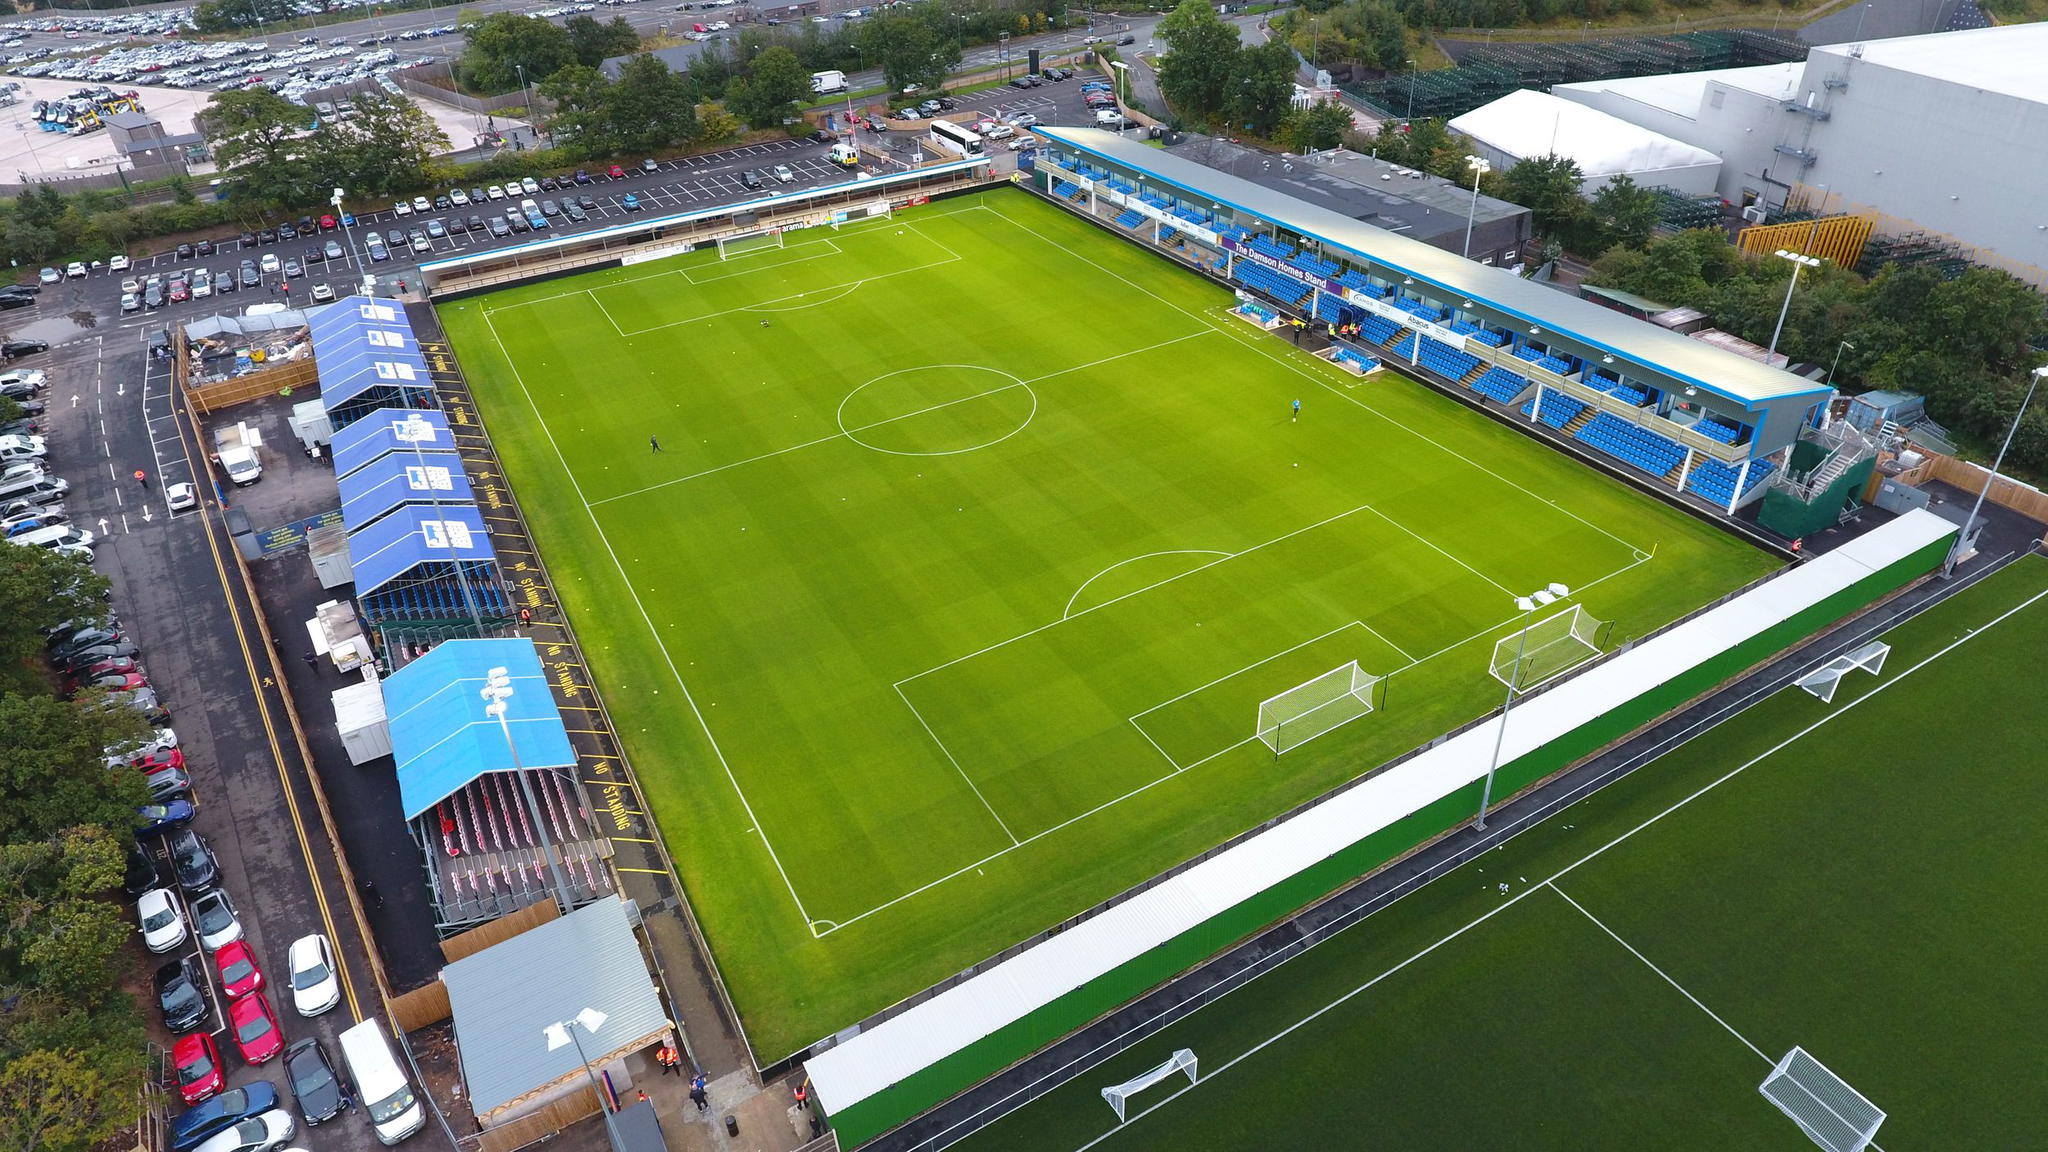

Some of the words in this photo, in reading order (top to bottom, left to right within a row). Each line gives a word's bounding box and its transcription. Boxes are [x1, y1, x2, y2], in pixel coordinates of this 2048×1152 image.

[1235, 242, 1248, 255] The
[1248, 248, 1277, 268] Damson
[1278, 260, 1304, 279] Homes
[1305, 272, 1328, 289] Stand
[1407, 315, 1430, 329] Abacus
[547, 645, 561, 656] NO
[554, 661, 577, 698] STANDING
[593, 761, 608, 775] NO
[603, 785, 631, 831] STANDING
